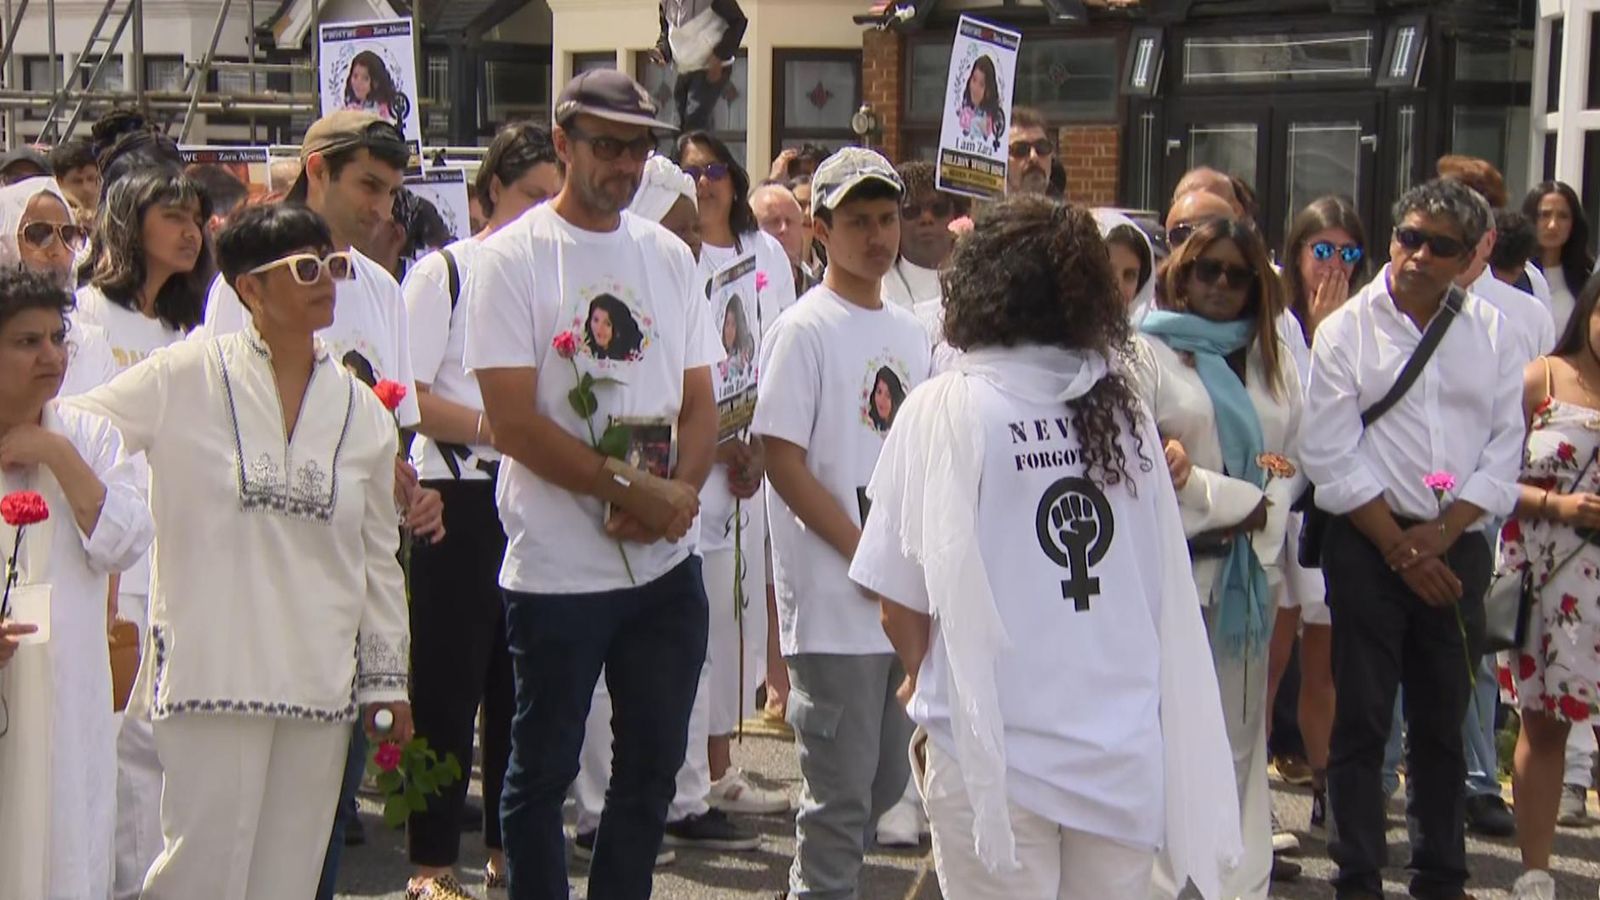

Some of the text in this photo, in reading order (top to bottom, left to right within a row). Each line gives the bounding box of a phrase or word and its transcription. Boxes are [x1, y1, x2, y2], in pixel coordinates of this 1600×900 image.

[960, 141, 976, 152] am
[218, 152, 237, 161] Zara
[239, 152, 266, 161] Aleena
[1008, 416, 1068, 443] NEV
